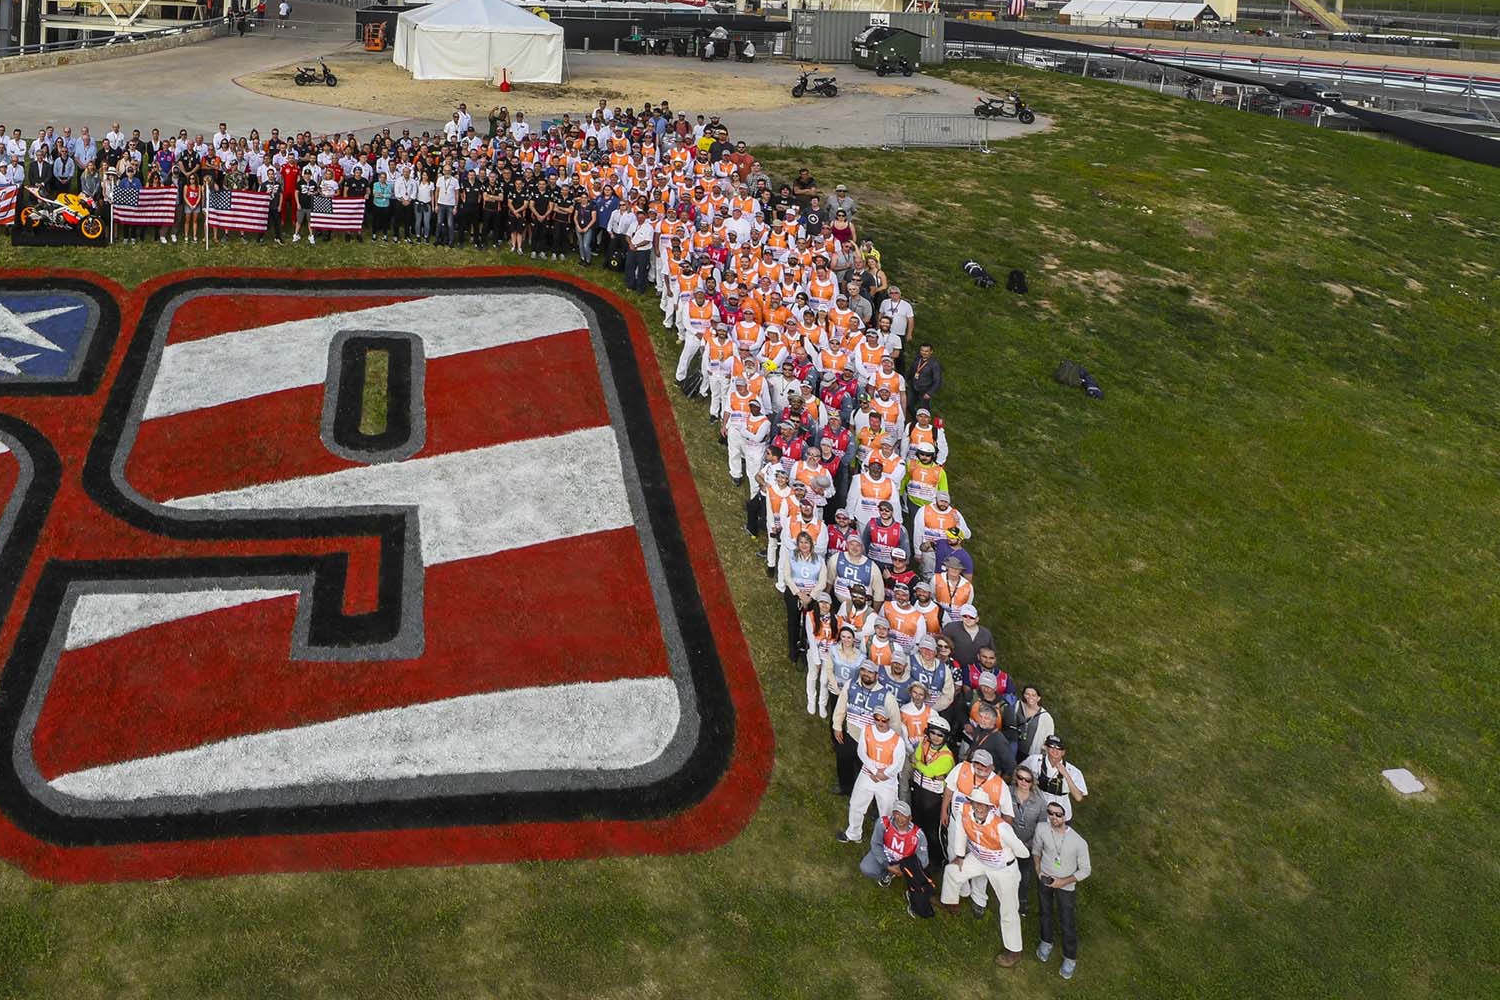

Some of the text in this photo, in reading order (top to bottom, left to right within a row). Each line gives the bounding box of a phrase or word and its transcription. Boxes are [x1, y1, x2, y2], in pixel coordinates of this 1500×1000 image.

[793, 368, 800, 377] M
[825, 395, 832, 405] M
[831, 439, 839, 448] M
[782, 446, 790, 456] M
[837, 538, 846, 550] M
[878, 532, 887, 544] M
[801, 567, 810, 578] G
[844, 567, 861, 582] PL
[841, 667, 850, 679] G
[855, 692, 872, 710] PL
[892, 837, 904, 853] M
